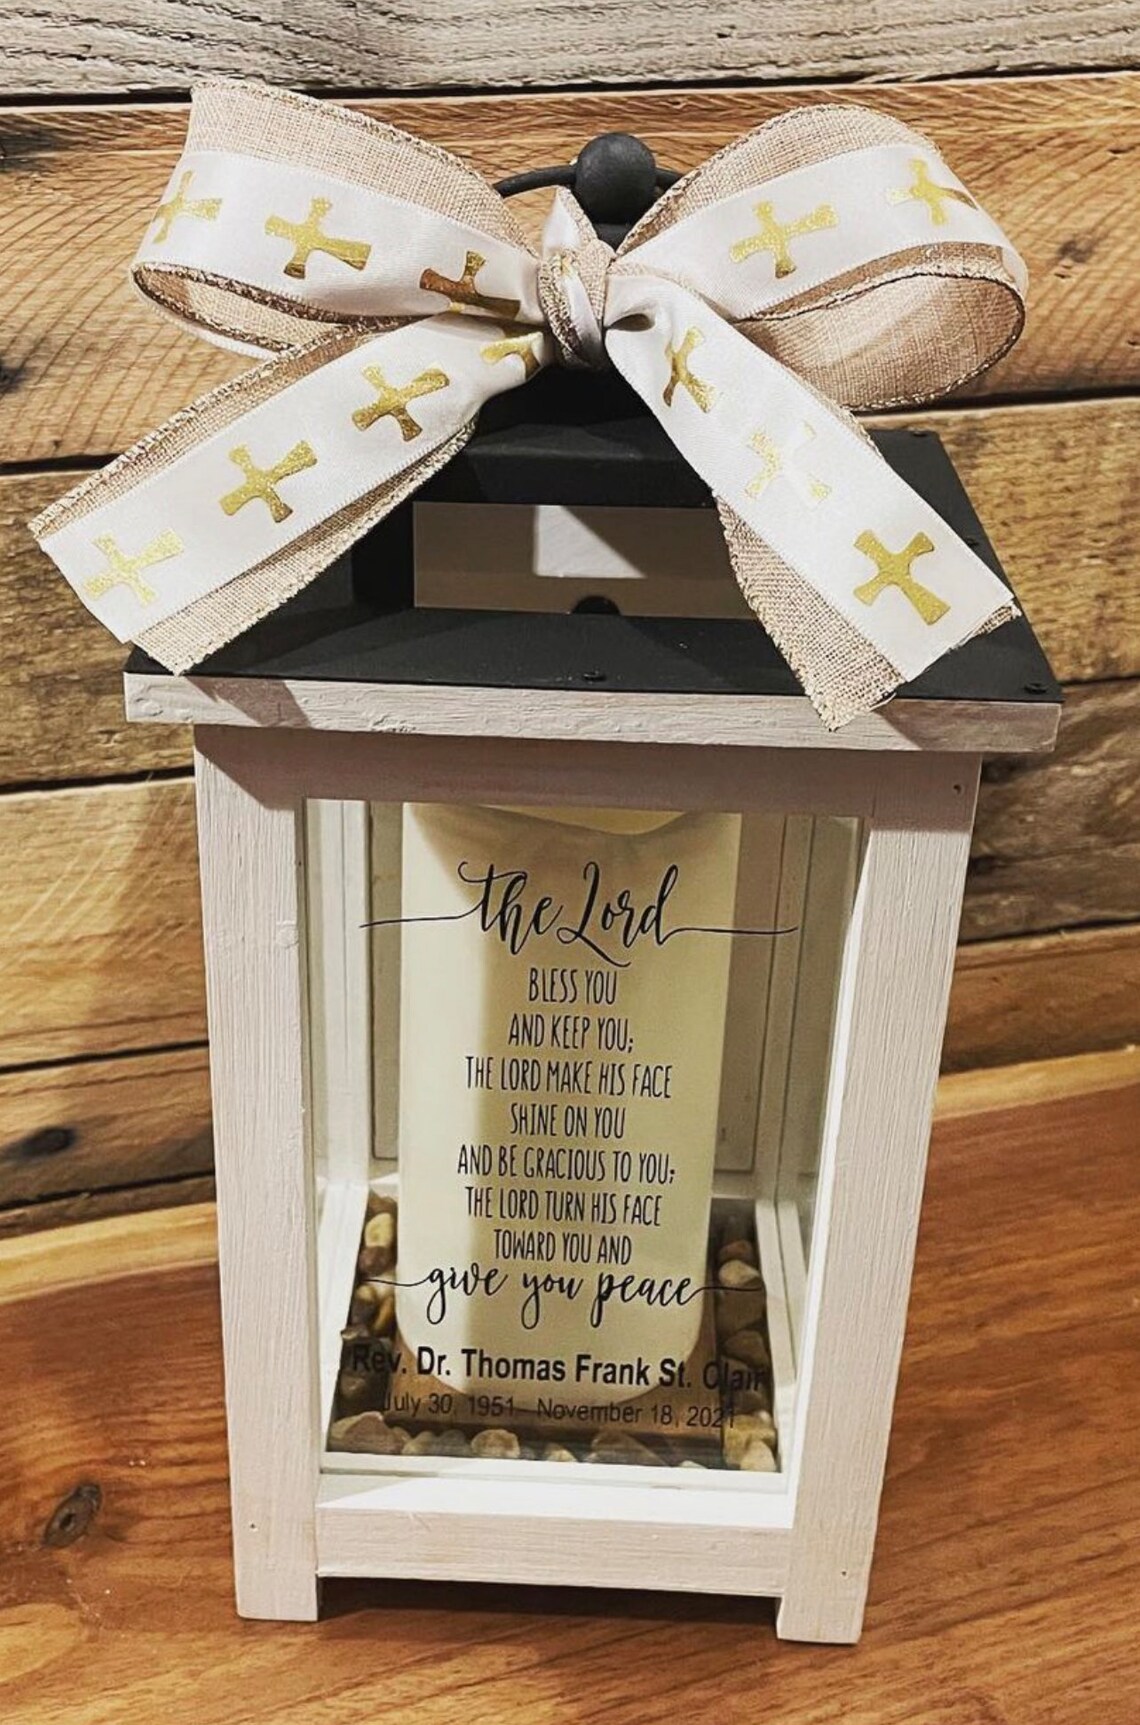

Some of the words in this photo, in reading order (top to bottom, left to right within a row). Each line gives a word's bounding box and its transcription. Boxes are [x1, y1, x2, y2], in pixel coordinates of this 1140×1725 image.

[438, 861, 564, 955] the
[557, 861, 706, 967] Lord
[529, 967, 578, 1003] BLESS
[585, 970, 617, 1005] YOU
[508, 1013, 545, 1048] AND
[551, 1014, 590, 1050] KEEP
[598, 1017, 633, 1053] YOU;
[465, 1056, 494, 1090] THE
[501, 1057, 541, 1092] LORD
[546, 1060, 593, 1094] MAKE
[599, 1062, 626, 1096] HIS
[632, 1064, 672, 1098] FACE
[510, 1102, 558, 1136] SHINE
[564, 1105, 587, 1138] ON
[594, 1107, 626, 1139] YOU
[457, 1144, 492, 1176] AND
[498, 1144, 517, 1177] BE
[524, 1147, 606, 1182] GRACIOUS
[612, 1150, 632, 1183] TO
[639, 1152, 675, 1185] YOU;
[464, 1186, 493, 1218] THE
[500, 1188, 539, 1220] LORD
[545, 1190, 585, 1222] TURN
[591, 1192, 617, 1224] HIS
[623, 1194, 662, 1227] FACE
[493, 1229, 556, 1262] TOWARD
[562, 1232, 592, 1263] YOU
[596, 1235, 632, 1265] AND
[403, 1263, 508, 1325] give
[521, 1273, 584, 1330] you
[590, 1272, 712, 1328] peace
[352, 1346, 407, 1375] Rev.
[417, 1346, 451, 1376] Dr.
[461, 1349, 566, 1382] Thomas
[575, 1354, 650, 1386] Frank
[659, 1358, 692, 1388] St.
[703, 1361, 764, 1392] Clair
[383, 1392, 422, 1417] July
[470, 1395, 515, 1417] 1951
[537, 1398, 643, 1424] November
[687, 1405, 735, 1430] 2021
